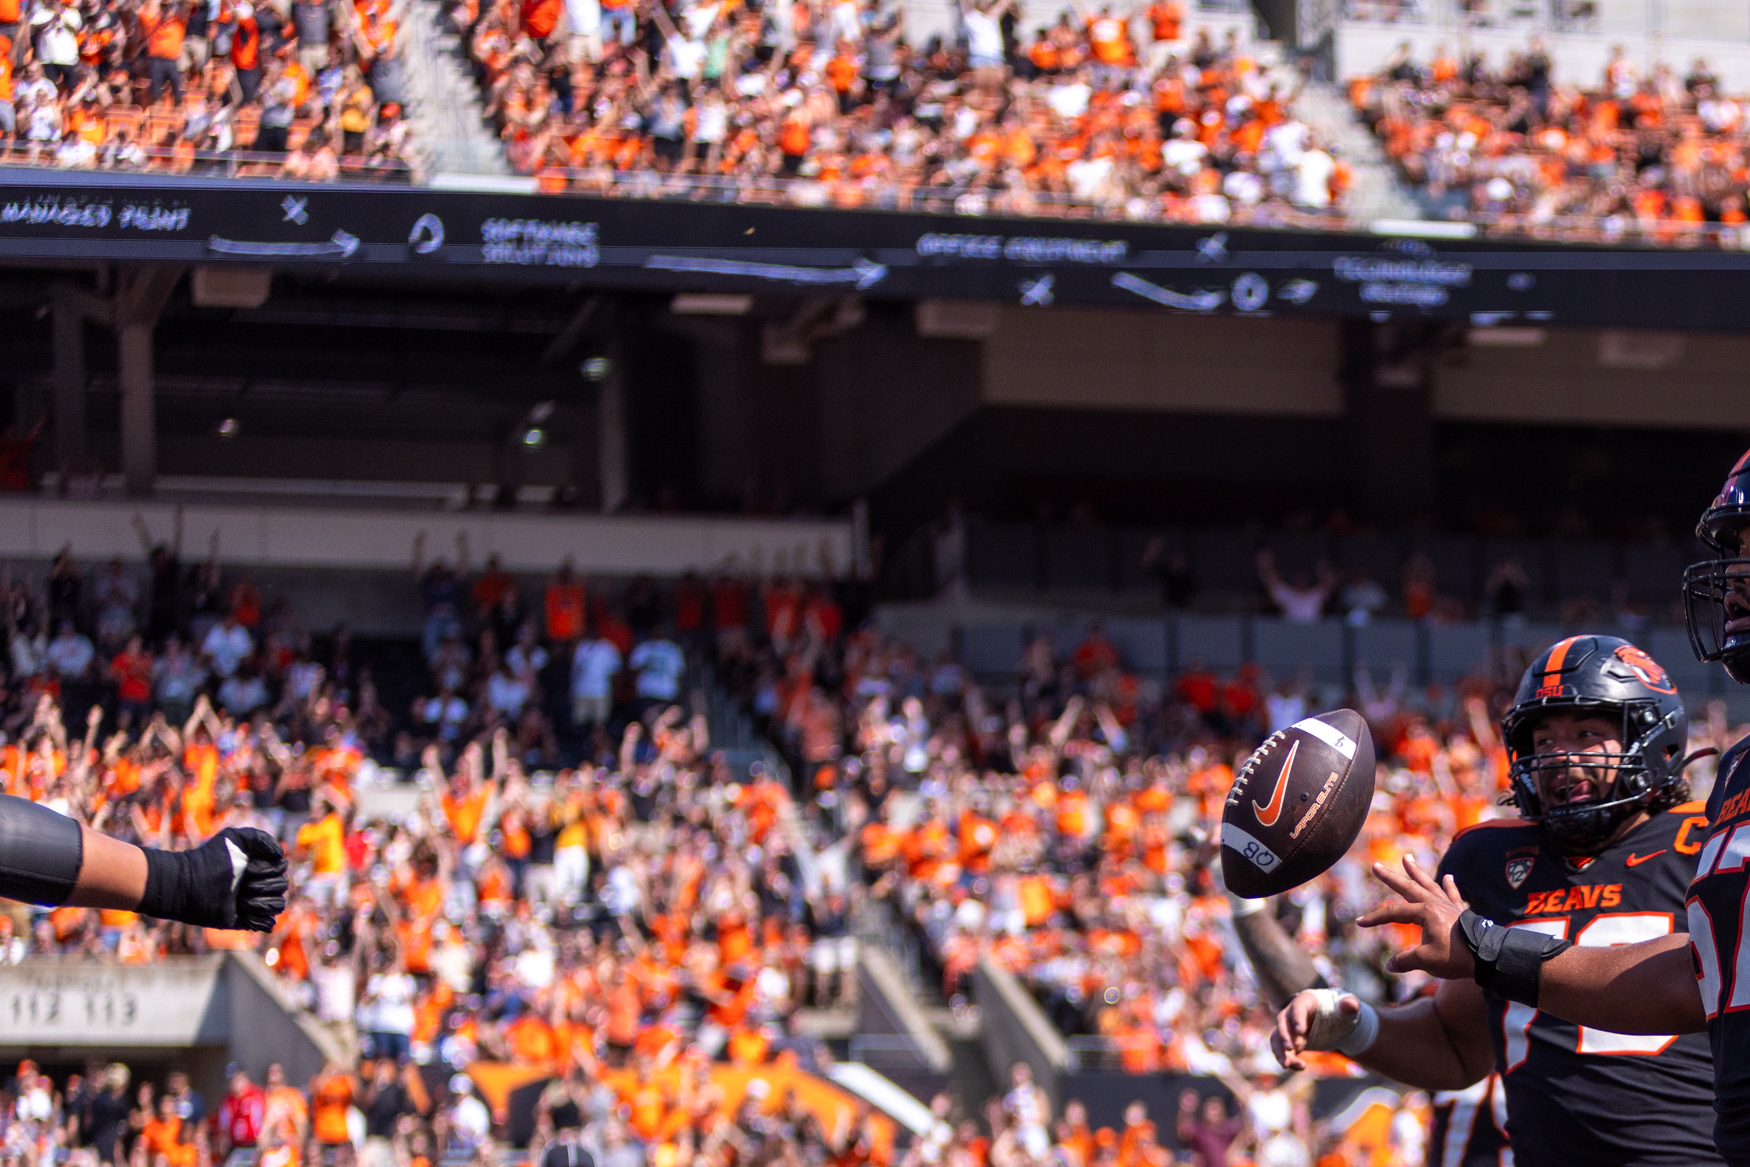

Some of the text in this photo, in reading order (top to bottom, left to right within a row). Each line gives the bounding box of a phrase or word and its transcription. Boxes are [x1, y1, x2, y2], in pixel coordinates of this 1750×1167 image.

[1289, 771, 1340, 839] VAPOR ELITE
[1243, 841, 1274, 866] QB
[1524, 883, 1623, 914] BEAVS
